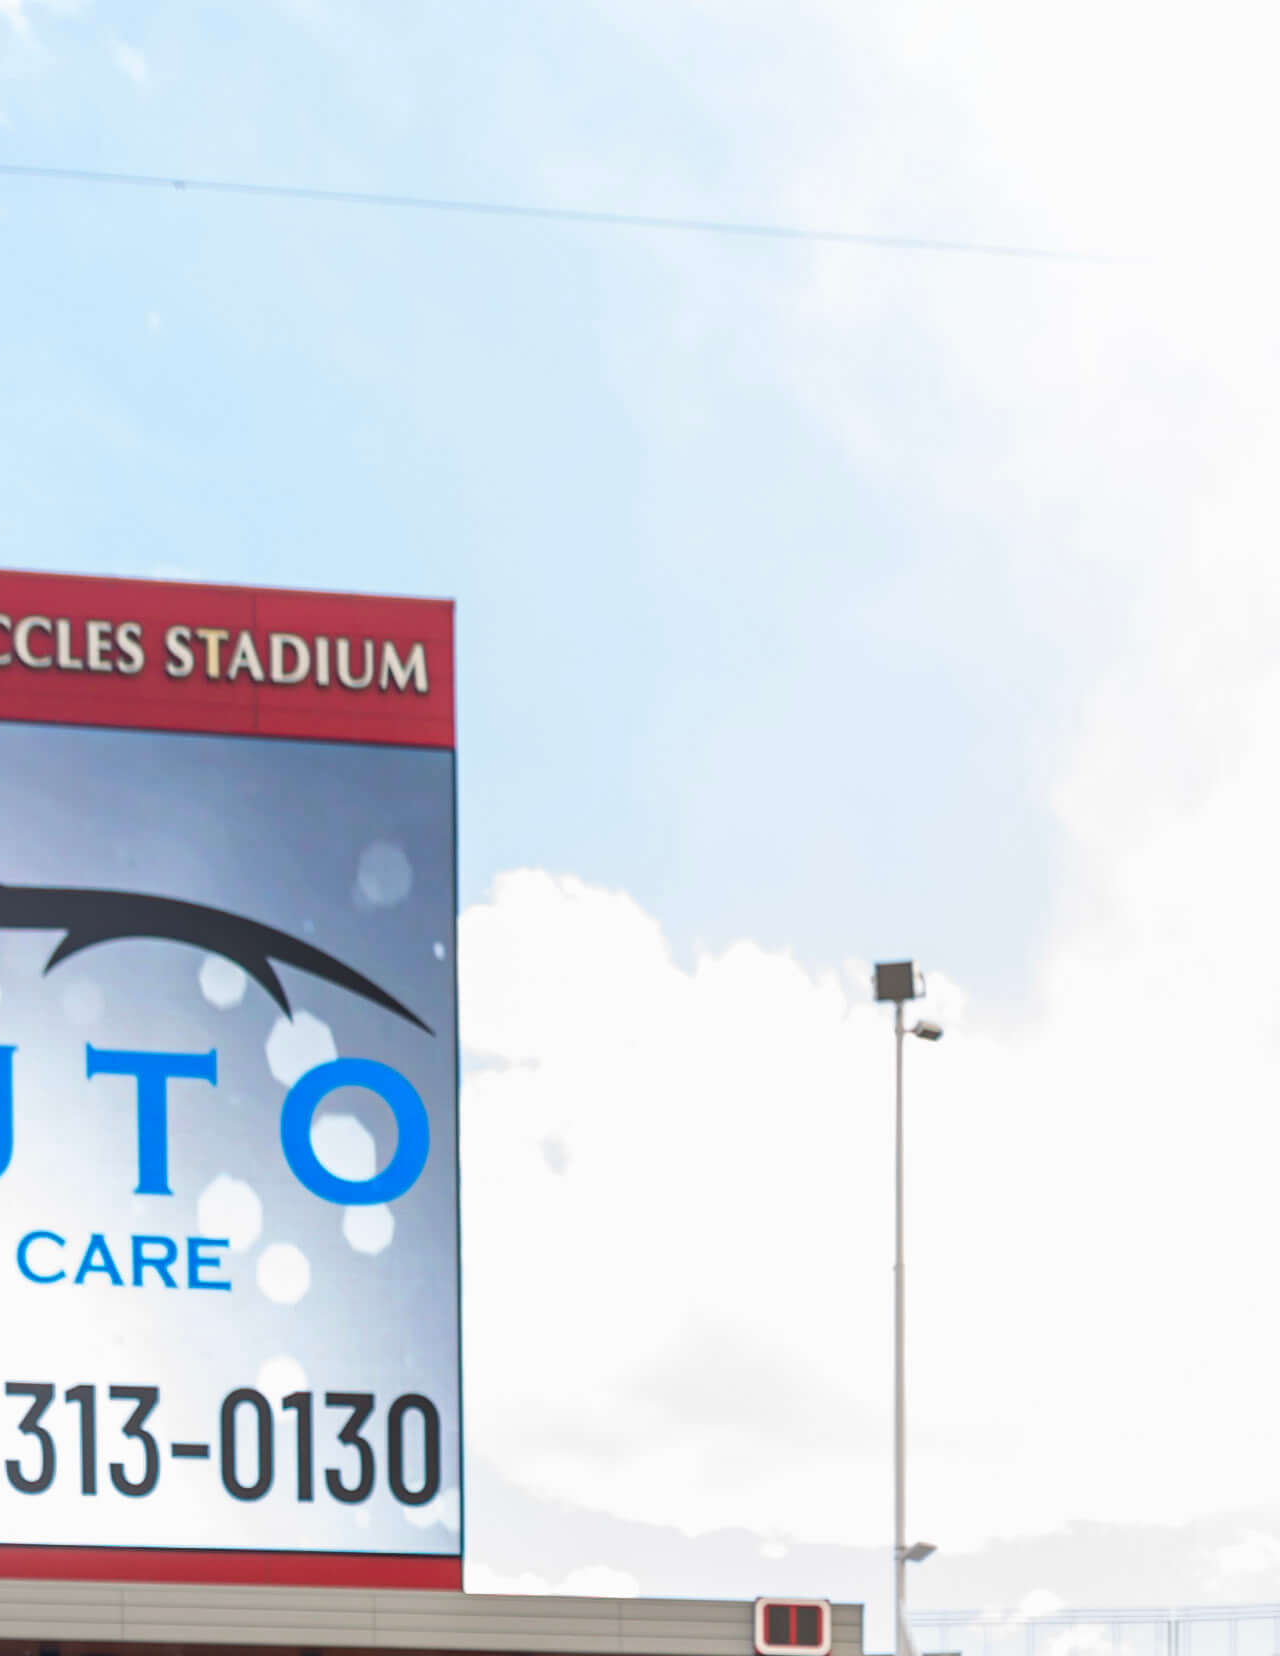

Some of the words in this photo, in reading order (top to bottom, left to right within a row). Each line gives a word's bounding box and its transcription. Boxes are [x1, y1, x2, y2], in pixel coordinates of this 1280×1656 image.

[164, 625, 429, 695] STADIUM
[16, 1230, 232, 1291] CARE
[4, 1380, 441, 1506] 313-0130
